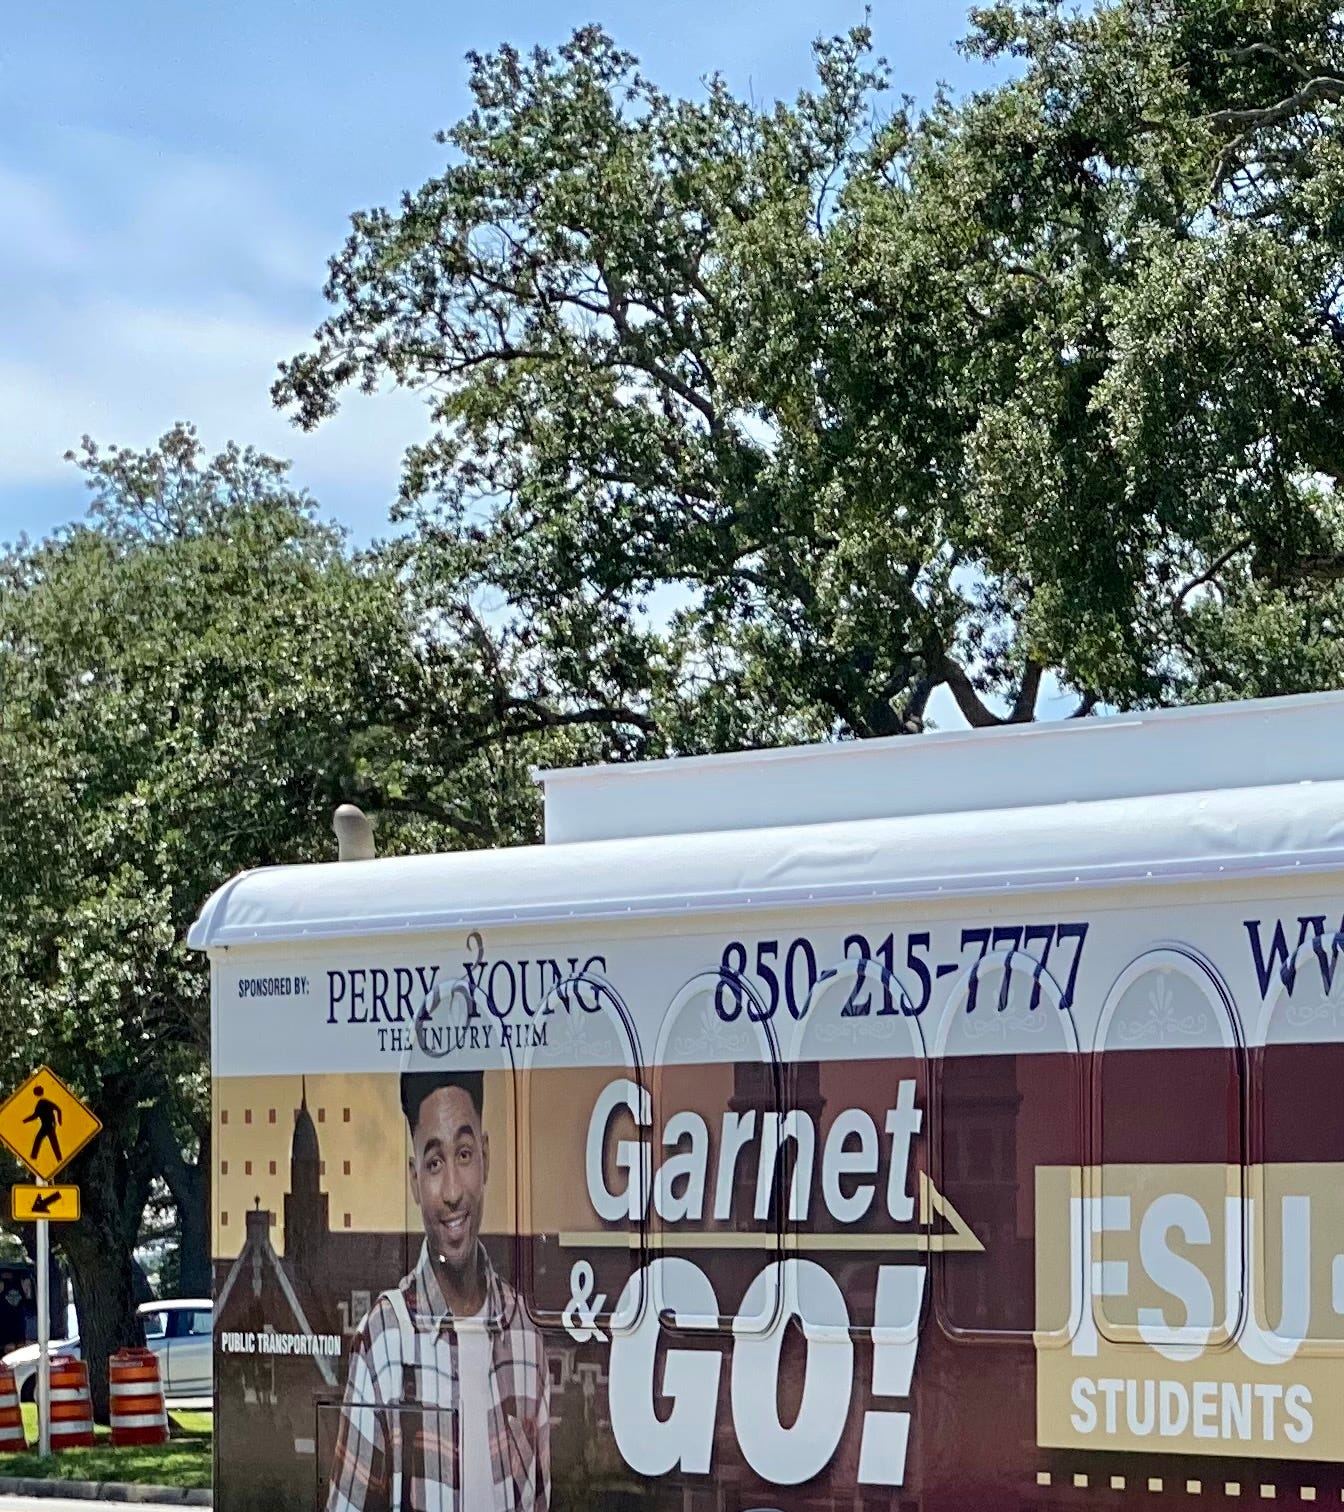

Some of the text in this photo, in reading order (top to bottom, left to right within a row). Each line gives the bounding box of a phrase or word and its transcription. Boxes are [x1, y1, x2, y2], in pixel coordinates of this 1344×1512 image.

[238, 975, 310, 998] SPONSORED BY:
[326, 965, 440, 1024] PERRY
[462, 955, 608, 1020] YOUNG
[714, 922, 1089, 1022] 850-215-7777
[423, 1024, 493, 1050] INJURY
[586, 1078, 923, 1223] Garnet
[1068, 1193, 1311, 1365] FSU
[221, 1332, 341, 1355] PUBLIC TRANSPORTATION
[562, 1256, 927, 1486] & GO!
[1070, 1377, 1313, 1444] STUDENTS
